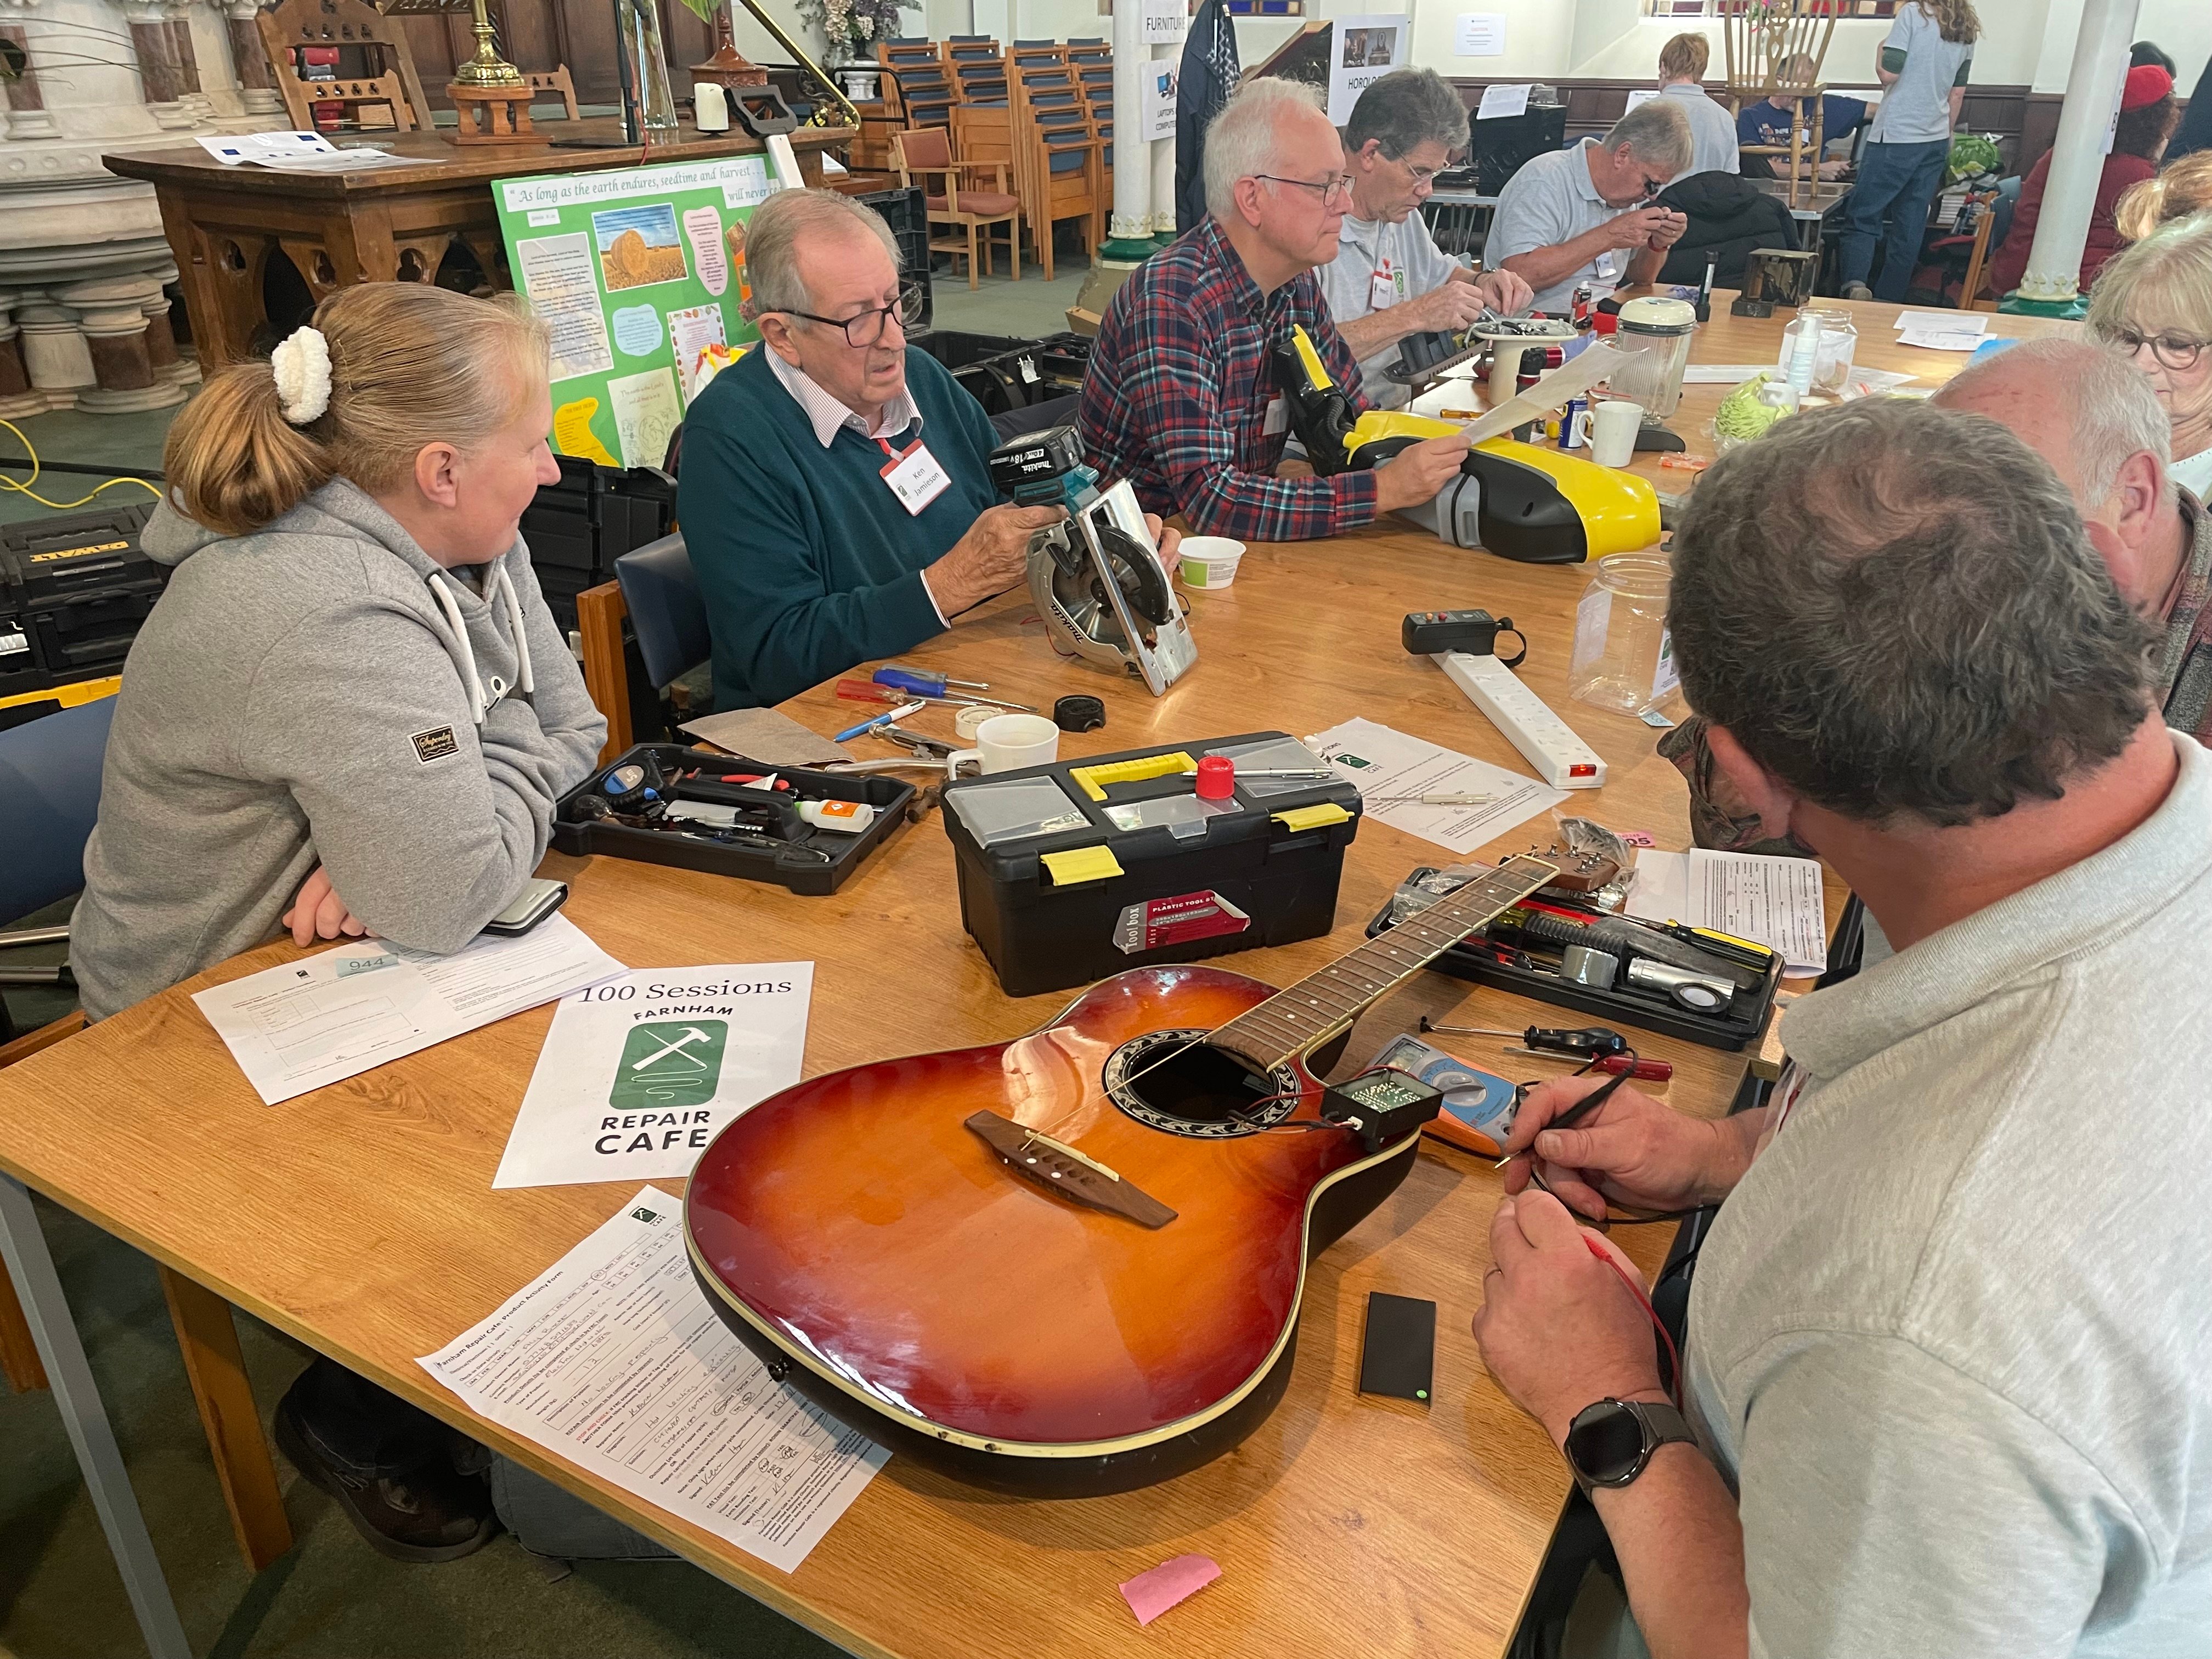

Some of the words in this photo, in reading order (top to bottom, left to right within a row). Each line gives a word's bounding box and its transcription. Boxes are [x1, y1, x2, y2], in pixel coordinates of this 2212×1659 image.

[1147, 17, 1185, 30] FURNITURE
[1158, 108, 1174, 117] LAPTOPS
[518, 189, 533, 202] As
[536, 187, 558, 206] long
[561, 185, 572, 198] as
[574, 181, 590, 196] the
[592, 179, 619, 194] earth
[621, 177, 659, 193] endures,
[661, 171, 698, 186] seedtime
[700, 167, 716, 182] and
[719, 166, 751, 179] harvest
[728, 188, 744, 201] will
[746, 184, 768, 199] never
[913, 468, 925, 479] Ken
[914, 472, 940, 496] Jamieson
[1126, 907, 1140, 926] box
[1153, 902, 1183, 912] PLASTIC
[1125, 927, 1139, 951] Tool
[349, 958, 385, 970] 944
[577, 985, 636, 1003] 100
[646, 980, 792, 1000] Sessions
[634, 1005, 733, 1021] FARNHAM
[601, 1110, 710, 1130] REPAIR
[595, 1128, 708, 1155] CAFE
[653, 1216, 667, 1227] CAFE
[465, 1333, 488, 1349] Repair
[500, 1300, 528, 1320] Product
[524, 1283, 549, 1301] Activity
[546, 1271, 564, 1283] Form
[546, 1402, 569, 1421] Description
[575, 1431, 588, 1441] STOP
[586, 1422, 597, 1431] AND
[619, 1387, 637, 1401] tracking
[732, 1404, 742, 1413] Yes
[581, 1426, 602, 1444] ANOTHER
[600, 1415, 613, 1426] FORM
[671, 1447, 682, 1457] END
[684, 1432, 698, 1444] repair
[659, 1472, 675, 1485] Repair
[671, 1459, 687, 1473] carried
[685, 1450, 696, 1459] over
[698, 1437, 709, 1446] next
[706, 1429, 716, 1438] FRC
[687, 1472, 699, 1483] Only
[697, 1465, 707, 1474] sign
[703, 1454, 717, 1466] when
[714, 1443, 728, 1455] repair
[725, 1434, 737, 1444] cycle
[706, 1500, 715, 1509] PAT
[713, 1492, 724, 1501] Test
[732, 1460, 754, 1481] completed
[725, 1508, 736, 1517] Earth
[734, 1493, 750, 1509] Bonding
[742, 1512, 757, 1526] Signed
